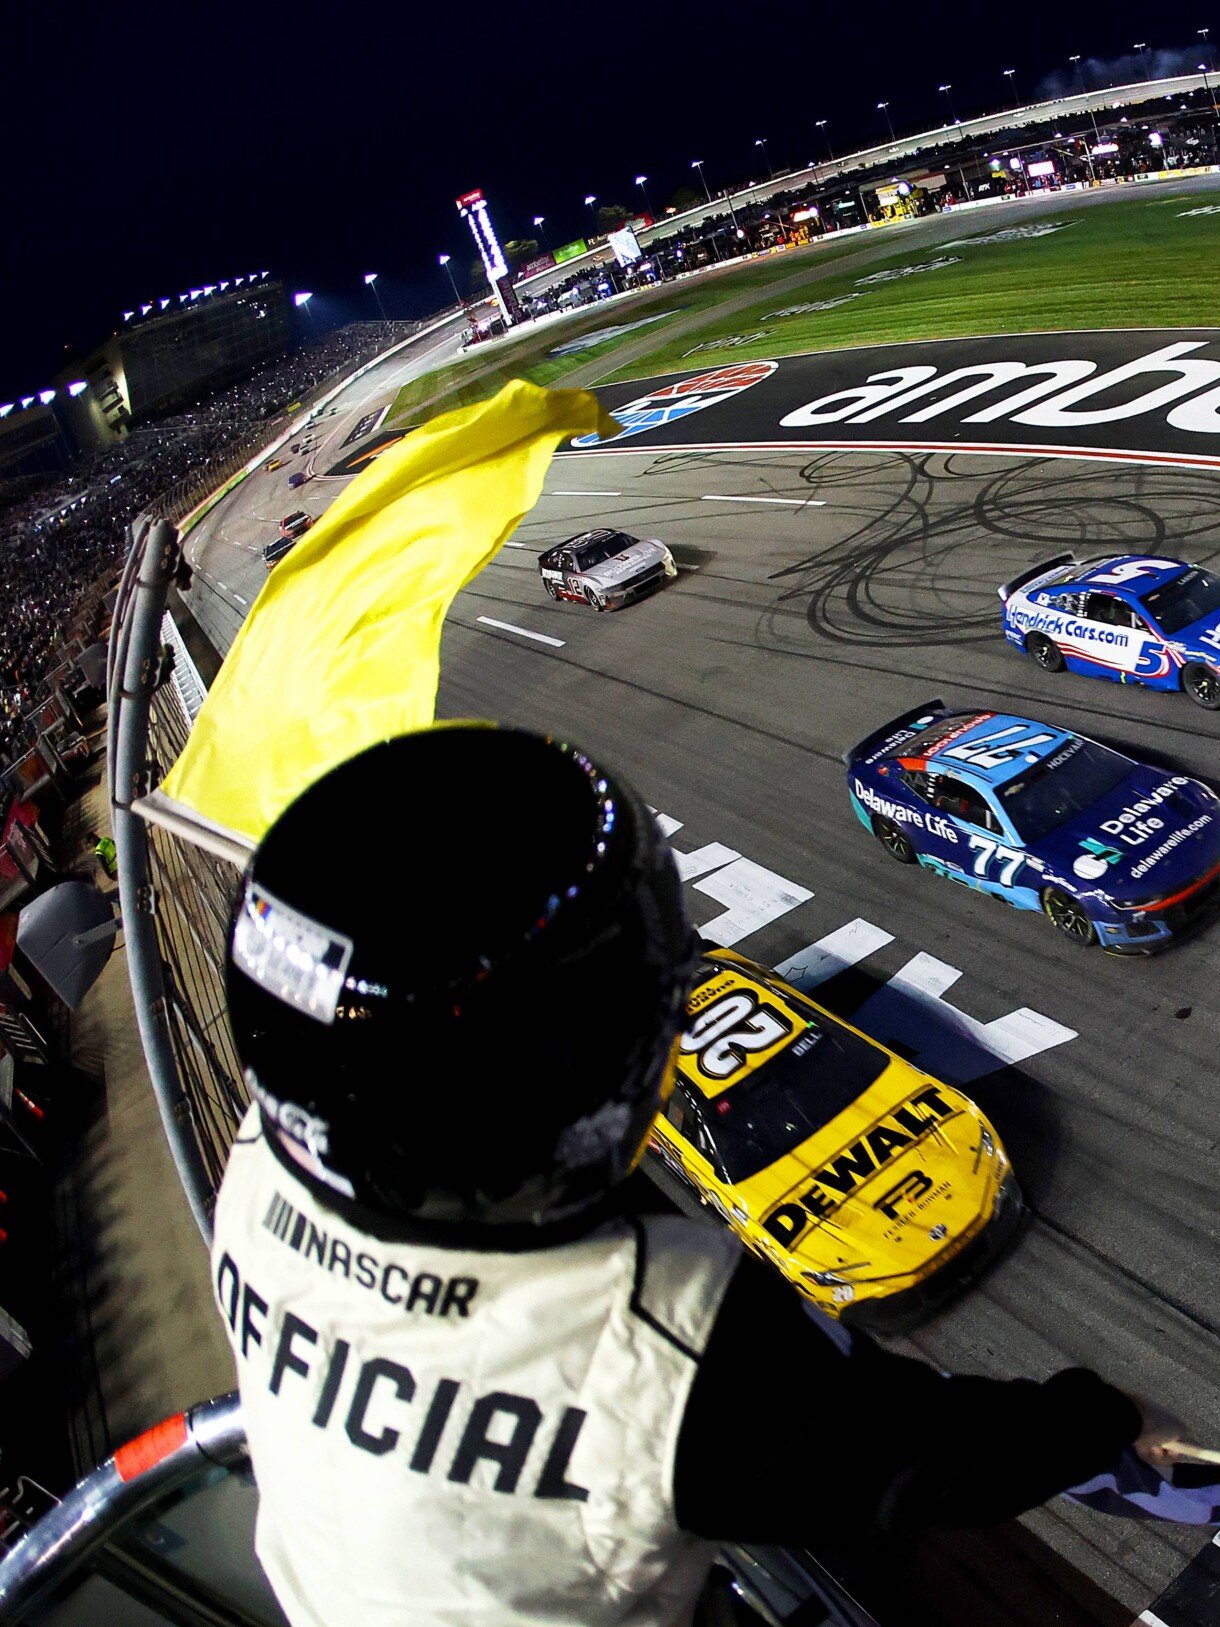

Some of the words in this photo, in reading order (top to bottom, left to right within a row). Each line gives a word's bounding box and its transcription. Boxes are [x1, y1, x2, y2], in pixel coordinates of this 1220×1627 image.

[566, 575, 583, 596] 12
[1134, 639, 1167, 675] 5
[943, 723, 1058, 771] 77
[854, 778, 924, 830] Delaware
[924, 812, 959, 844] Life
[1100, 775, 1190, 837] Delaware
[1119, 816, 1166, 846] Life
[967, 835, 1026, 889] 77
[1129, 813, 1214, 879] delawarelife.com
[681, 990, 793, 1078] 20
[760, 1087, 954, 1249] DEWALT
[305, 1222, 480, 1319] NASCAR
[217, 1251, 590, 1503] OFFICIAL
